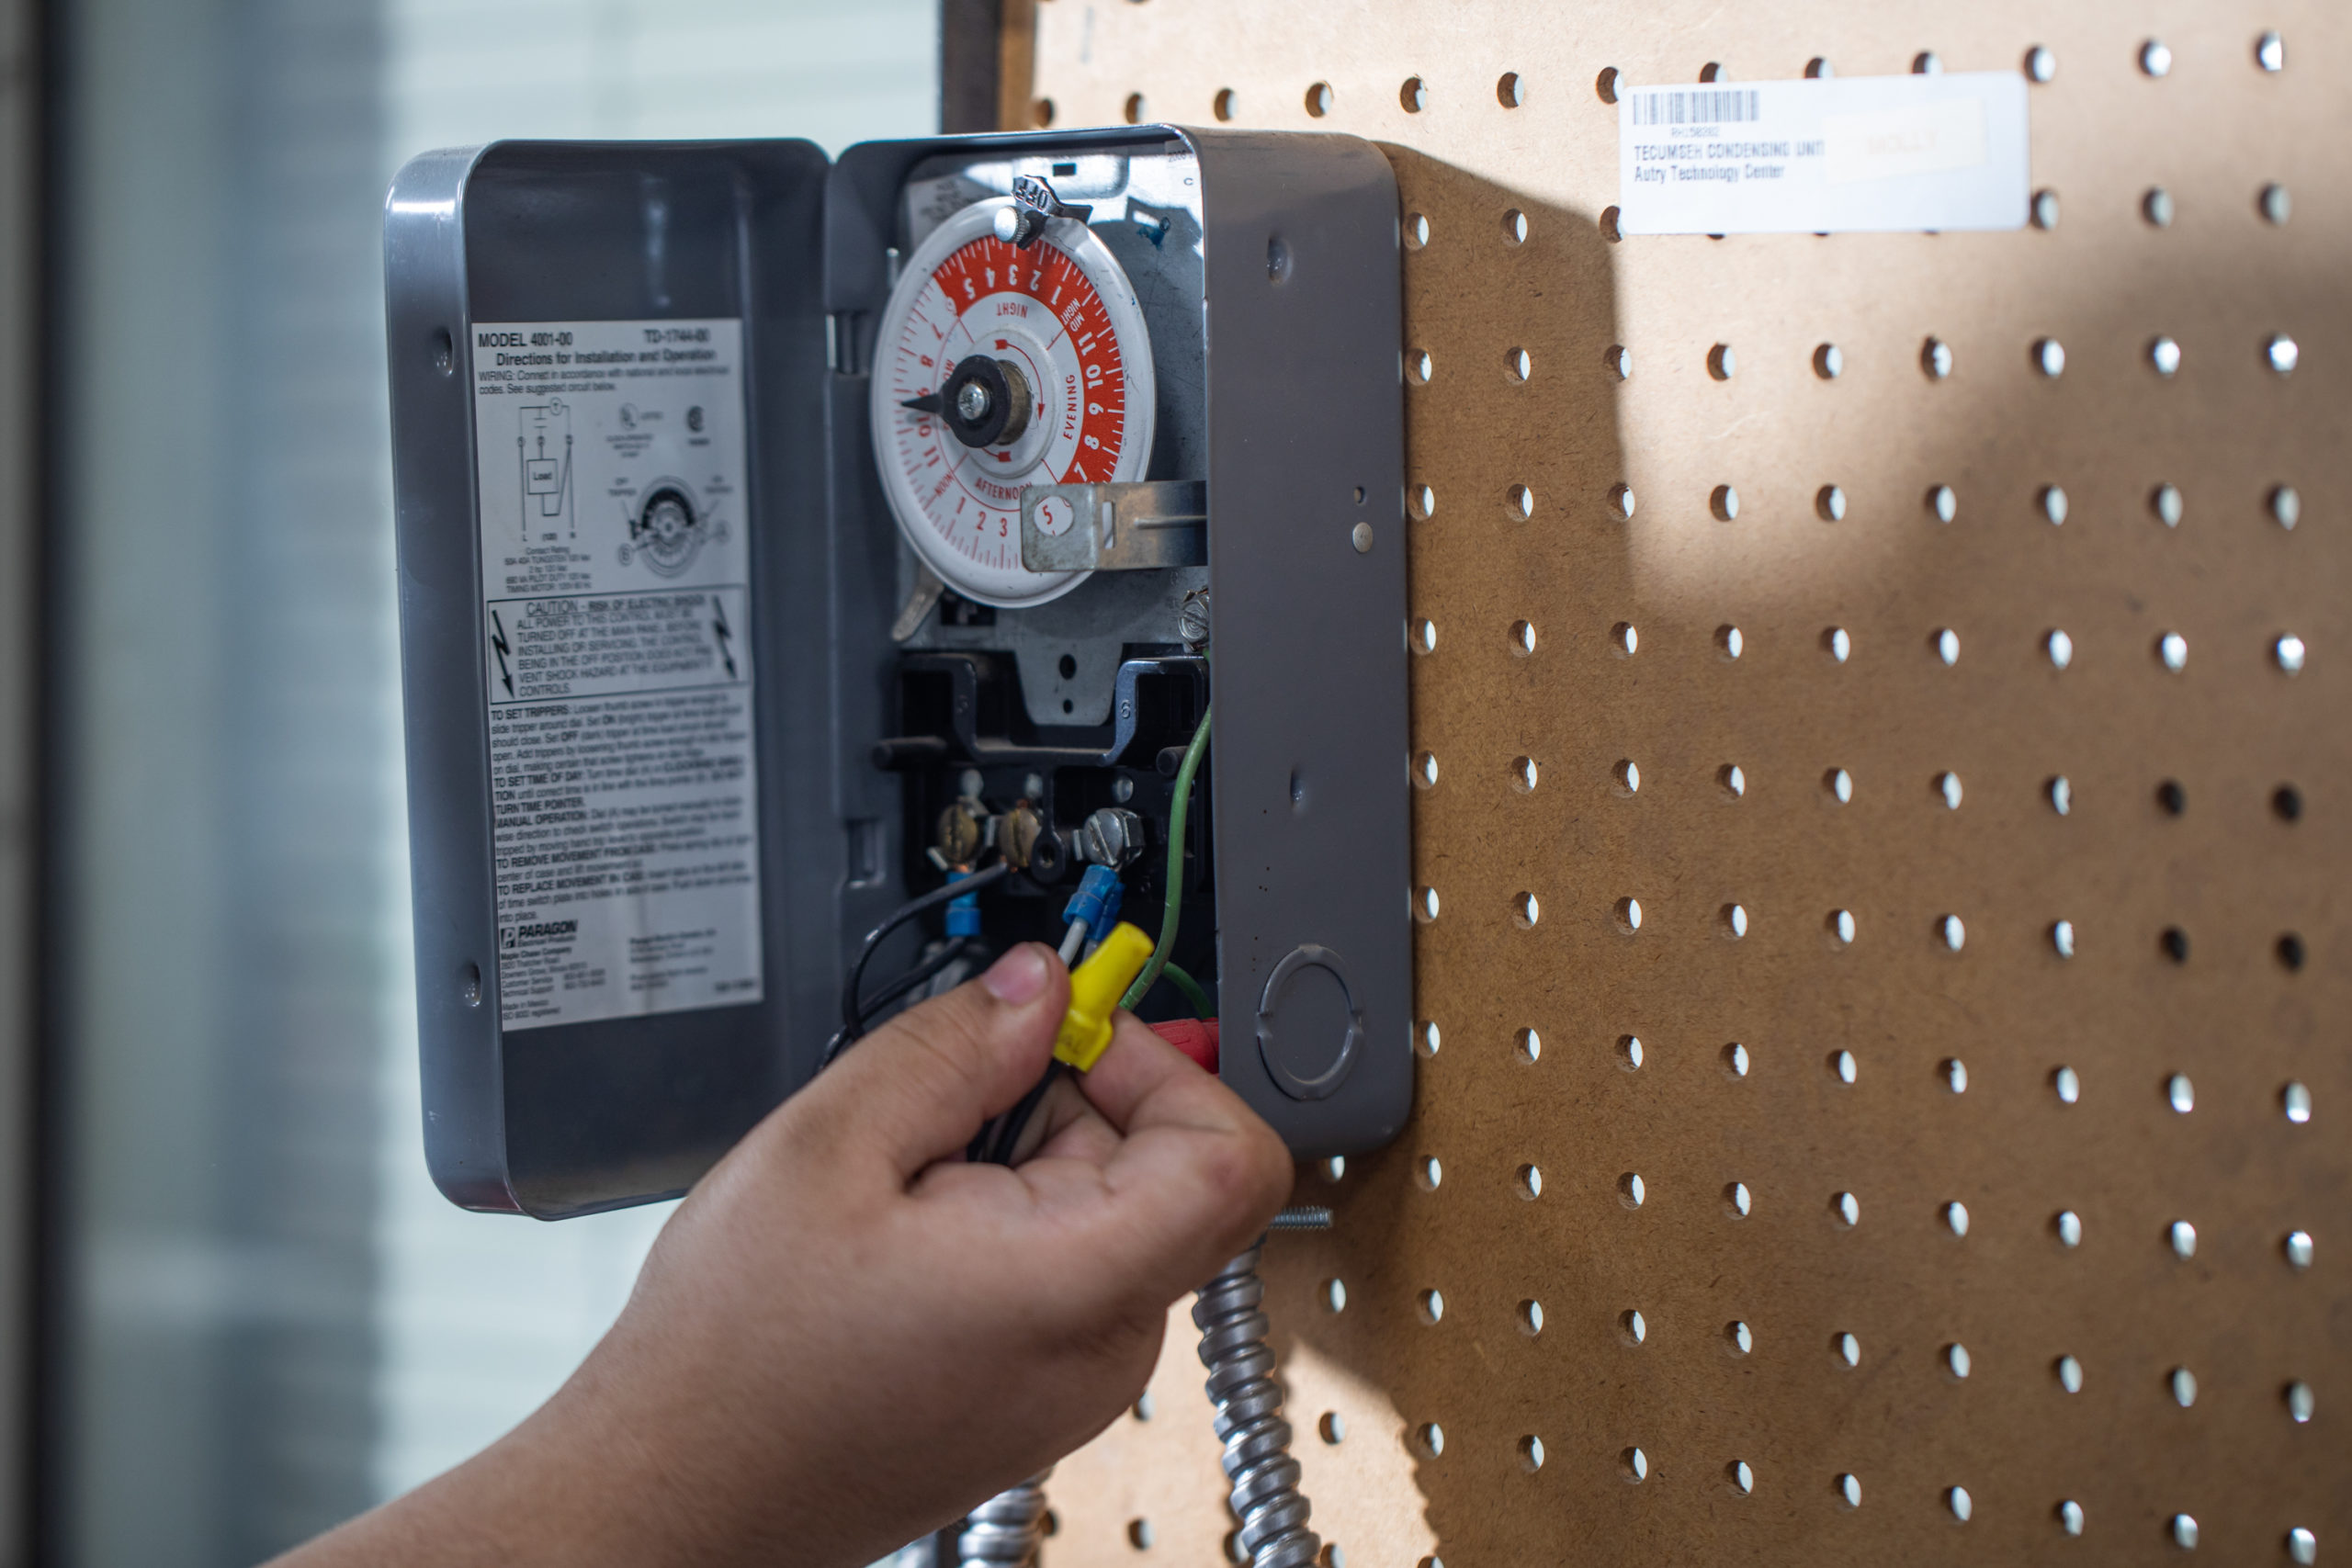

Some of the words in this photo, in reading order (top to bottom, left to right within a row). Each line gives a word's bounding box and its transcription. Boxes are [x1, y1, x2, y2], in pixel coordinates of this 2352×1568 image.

[1634, 144, 1702, 162] TECUMSEH
[1708, 141, 1790, 159] CONDENSING
[1634, 166, 1667, 184] Autry
[1671, 164, 1739, 183] Technology
[1746, 164, 1784, 179] Center
[986, 267, 995, 288] 4
[1009, 265, 1018, 286] 3
[1030, 269, 1041, 291] 2
[963, 277, 976, 299] 5
[1051, 285, 1062, 305] 1
[996, 302, 1028, 319] NIGHT
[1060, 298, 1080, 325] NIGHT
[1069, 312, 1085, 332] MID
[478, 333, 527, 347] MODEL
[530, 332, 573, 346] 4001-00
[1078, 332, 1096, 356] 11
[496, 352, 553, 366] Directions
[556, 351, 571, 364] for
[575, 350, 636, 364] Installation
[639, 351, 661, 362] and
[662, 348, 717, 363] Operation
[478, 370, 515, 381] WIRING:
[1086, 364, 1103, 389] 10
[506, 383, 524, 393] See
[526, 382, 567, 395] suggested
[1062, 374, 1078, 441] EVENING
[1089, 402, 1103, 415] 9
[1084, 434, 1100, 450] 8
[533, 471, 553, 480] Load
[1074, 461, 1088, 482] 7
[975, 477, 1032, 502] AFTERNO
[977, 511, 987, 531] 2
[1042, 505, 1053, 525] 5
[1000, 517, 1008, 537] 3
[526, 600, 578, 616] CAUTION
[517, 619, 535, 629] ALL
[536, 616, 570, 627] POWER
[572, 615, 584, 626] TO
[587, 613, 607, 625] THIS
[517, 630, 556, 642] TURNED
[558, 628, 575, 640] OFF
[591, 626, 609, 637] THE
[517, 643, 570, 656] INSTALLING
[518, 658, 548, 670] BEING
[548, 656, 560, 667] IN
[560, 655, 579, 666] THE
[519, 671, 544, 683] VENT
[546, 668, 579, 682] SHOCK
[491, 710, 503, 720] TO
[505, 707, 525, 719] SET
[525, 705, 571, 717] TRIPPERS:
[492, 725, 510, 735] slide
[512, 723, 537, 735] tripper
[539, 720, 567, 731] around
[492, 738, 518, 749] should
[560, 730, 579, 741] OFF
[492, 752, 514, 764] open.
[516, 750, 533, 760] Add
[535, 747, 565, 760] trippers
[493, 766, 503, 775] on
[523, 761, 553, 774] making
[493, 777, 507, 788] TO
[508, 775, 526, 787] SET
[527, 773, 548, 784] TIME
[550, 772, 563, 783] OF
[495, 790, 516, 801] TION
[518, 788, 535, 799] until
[495, 802, 520, 815] TURN
[521, 801, 542, 813] TIME
[494, 816, 533, 828] MANUAL
[496, 833, 514, 843] wise
[515, 829, 550, 840] direction
[553, 828, 561, 838] to
[496, 845, 525, 858] tripped
[526, 842, 536, 855] by
[537, 840, 569, 854] moving
[497, 859, 509, 870] TO
[511, 853, 550, 868] REMOVE
[551, 848, 604, 863] MOVEMENT
[497, 872, 524, 883] center
[525, 869, 534, 880] of
[536, 868, 556, 879] case
[557, 865, 573, 876] and
[498, 885, 511, 897] TO
[512, 879, 555, 894] REPLACE
[556, 874, 607, 889] MOVEMENT
[498, 898, 507, 910] of
[508, 897, 526, 908] time
[527, 895, 552, 906] switch
[499, 912, 514, 923] into
[517, 919, 579, 939] PARAGON
